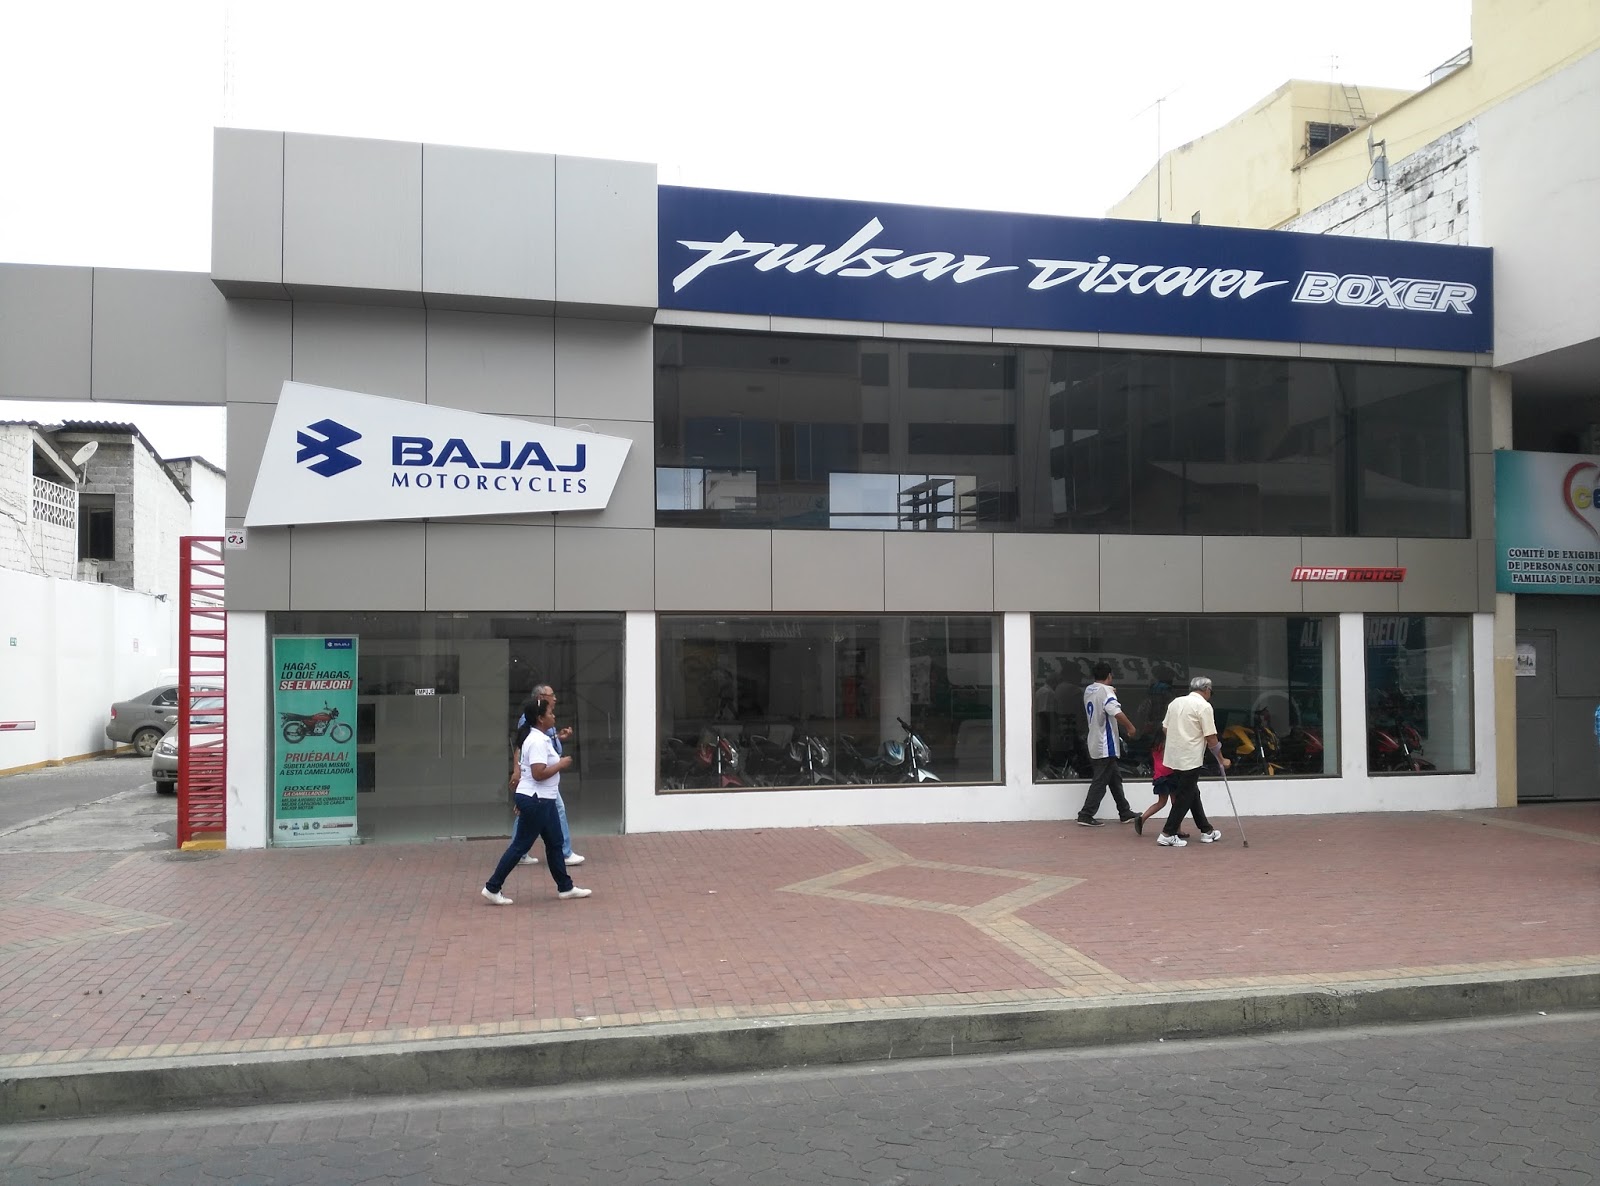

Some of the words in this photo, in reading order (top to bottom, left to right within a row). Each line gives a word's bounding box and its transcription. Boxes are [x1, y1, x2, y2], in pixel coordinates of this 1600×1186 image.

[1291, 270, 1478, 314] BOXER
[392, 436, 586, 472] BAJAJ
[391, 472, 587, 493] MOTORCYCLES
[1508, 547, 1545, 558] COMITÉ
[1547, 550, 1560, 559] DE
[1508, 561, 1521, 570] DE
[1523, 562, 1573, 571] PERSONAS
[1575, 563, 1595, 572] CON
[1512, 573, 1557, 583] FAMILIAS
[1559, 575, 1572, 584] DE
[1574, 575, 1586, 584] LA
[283, 662, 317, 671] HAGAS
[280, 671, 293, 680] LO
[295, 671, 314, 680] QUE
[316, 670, 351, 680] HAGAS,
[280, 680, 294, 690] SE
[295, 680, 308, 690] EL
[309, 680, 351, 690] MEJOR!
[1087, 701, 1094, 724] 9
[284, 750, 349, 763] PRUÉBALA!
